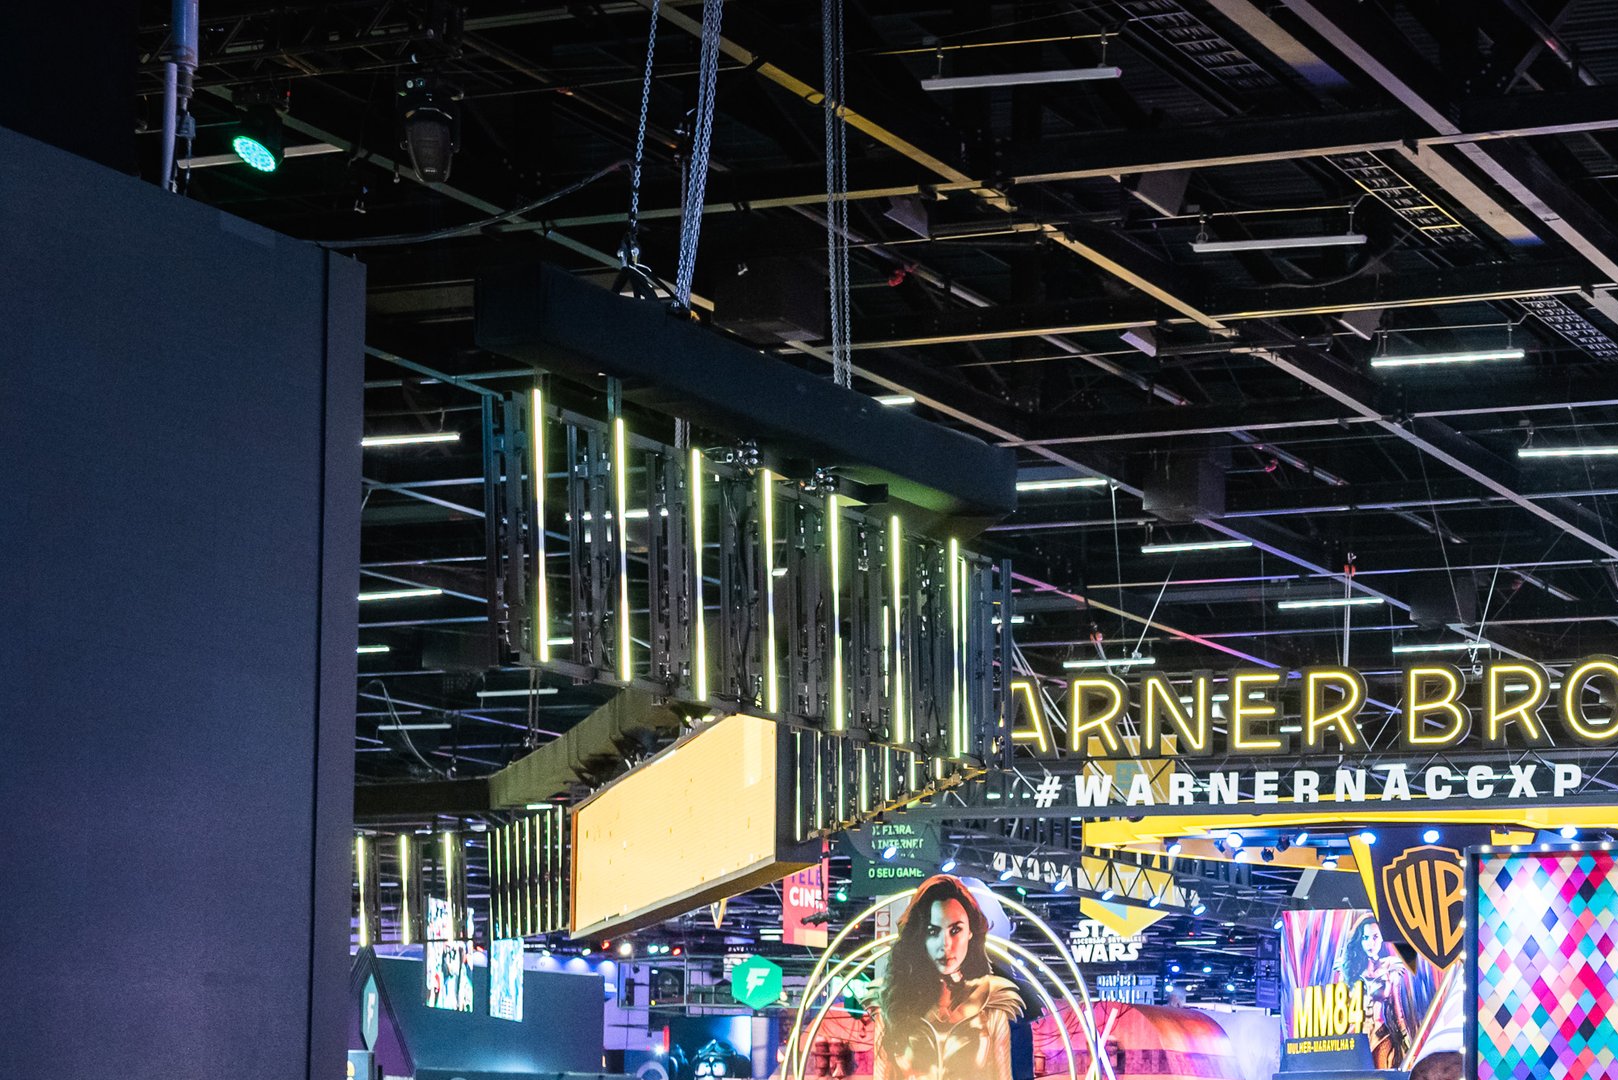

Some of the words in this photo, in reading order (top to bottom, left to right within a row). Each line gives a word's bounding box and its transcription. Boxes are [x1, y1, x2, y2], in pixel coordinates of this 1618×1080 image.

[1010, 667, 1366, 757] ARNER
[1035, 763, 1584, 810] #WARNERNACCXP
[1070, 919, 1142, 938] STA
[1071, 943, 1142, 963] WARS
[1293, 980, 1364, 1039] MM84
